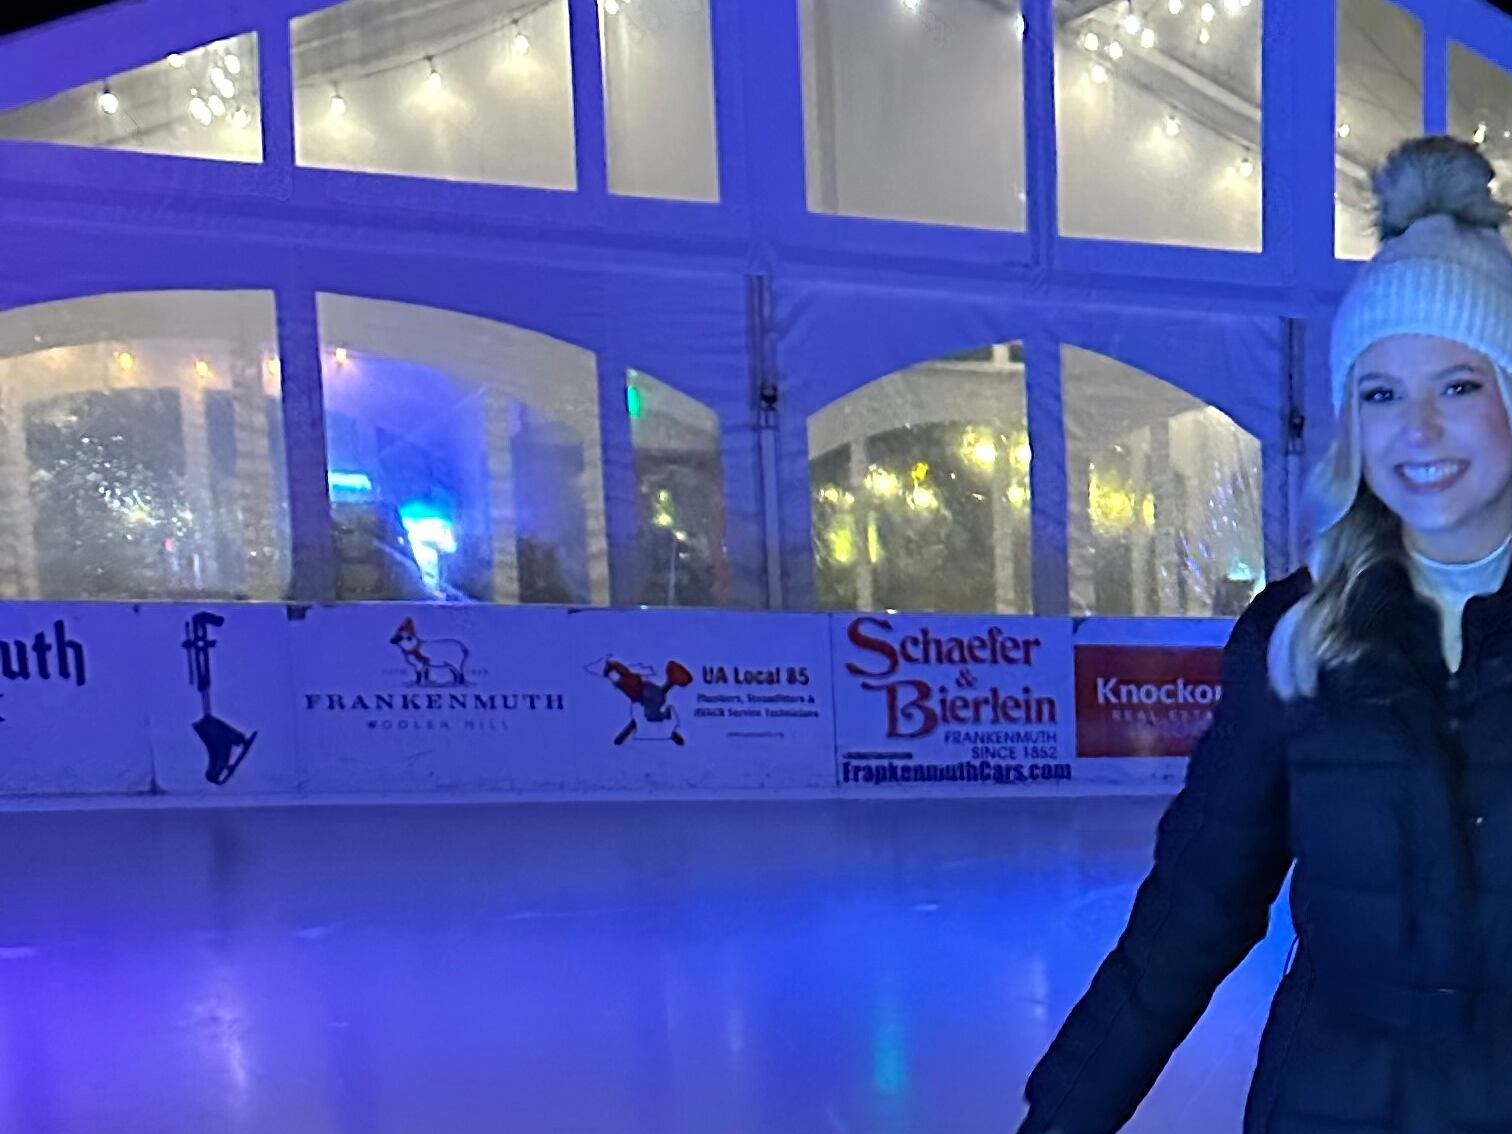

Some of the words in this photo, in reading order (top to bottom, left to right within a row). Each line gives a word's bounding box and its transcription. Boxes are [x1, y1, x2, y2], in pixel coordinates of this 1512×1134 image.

[845, 616, 1041, 678] Schaefer
[702, 665, 728, 685] UA
[734, 665, 780, 685] Local
[786, 666, 810, 685] 85
[955, 668, 977, 689] &
[304, 693, 565, 710] FRANKENMUTH
[861, 679, 1057, 740] Bierlein
[1111, 709, 1159, 721] REAL
[464, 719, 509, 731] MILL
[944, 730, 1057, 744] FRANKENMUTH
[971, 746, 1017, 759] SINCE
